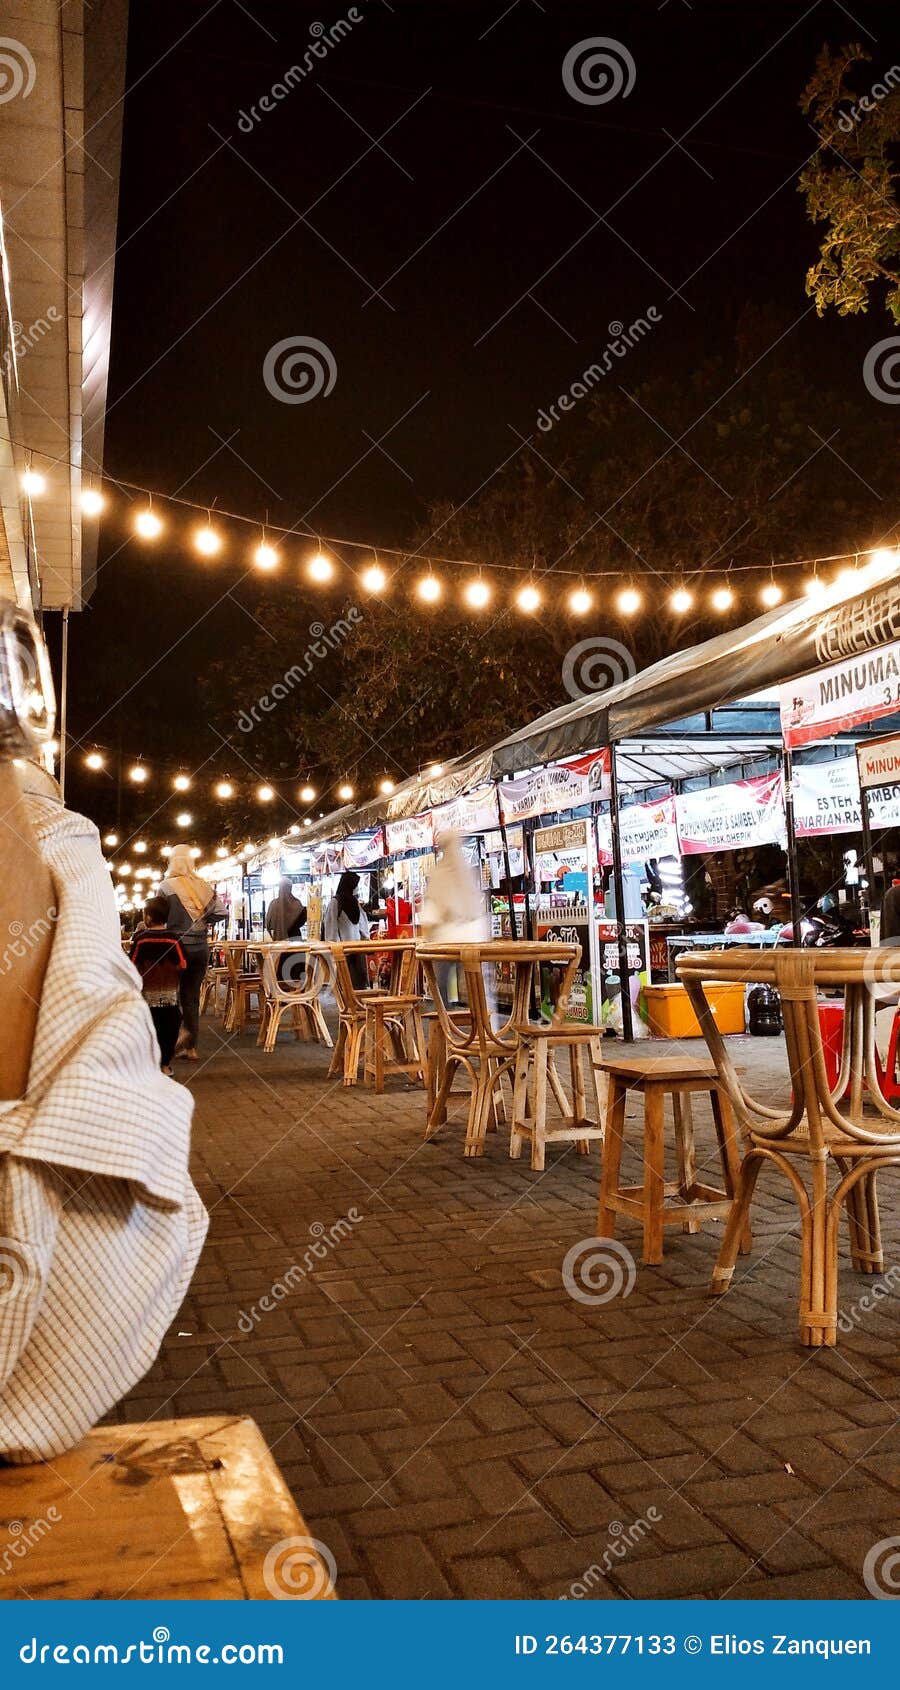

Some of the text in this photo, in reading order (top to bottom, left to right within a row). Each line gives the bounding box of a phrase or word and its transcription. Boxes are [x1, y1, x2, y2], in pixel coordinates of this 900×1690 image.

[819, 647, 900, 706] MINUMA
[817, 797, 829, 811] ES
[831, 795, 852, 809] TEH
[844, 808, 875, 824] RAA
[603, 957, 643, 969] JUBO
